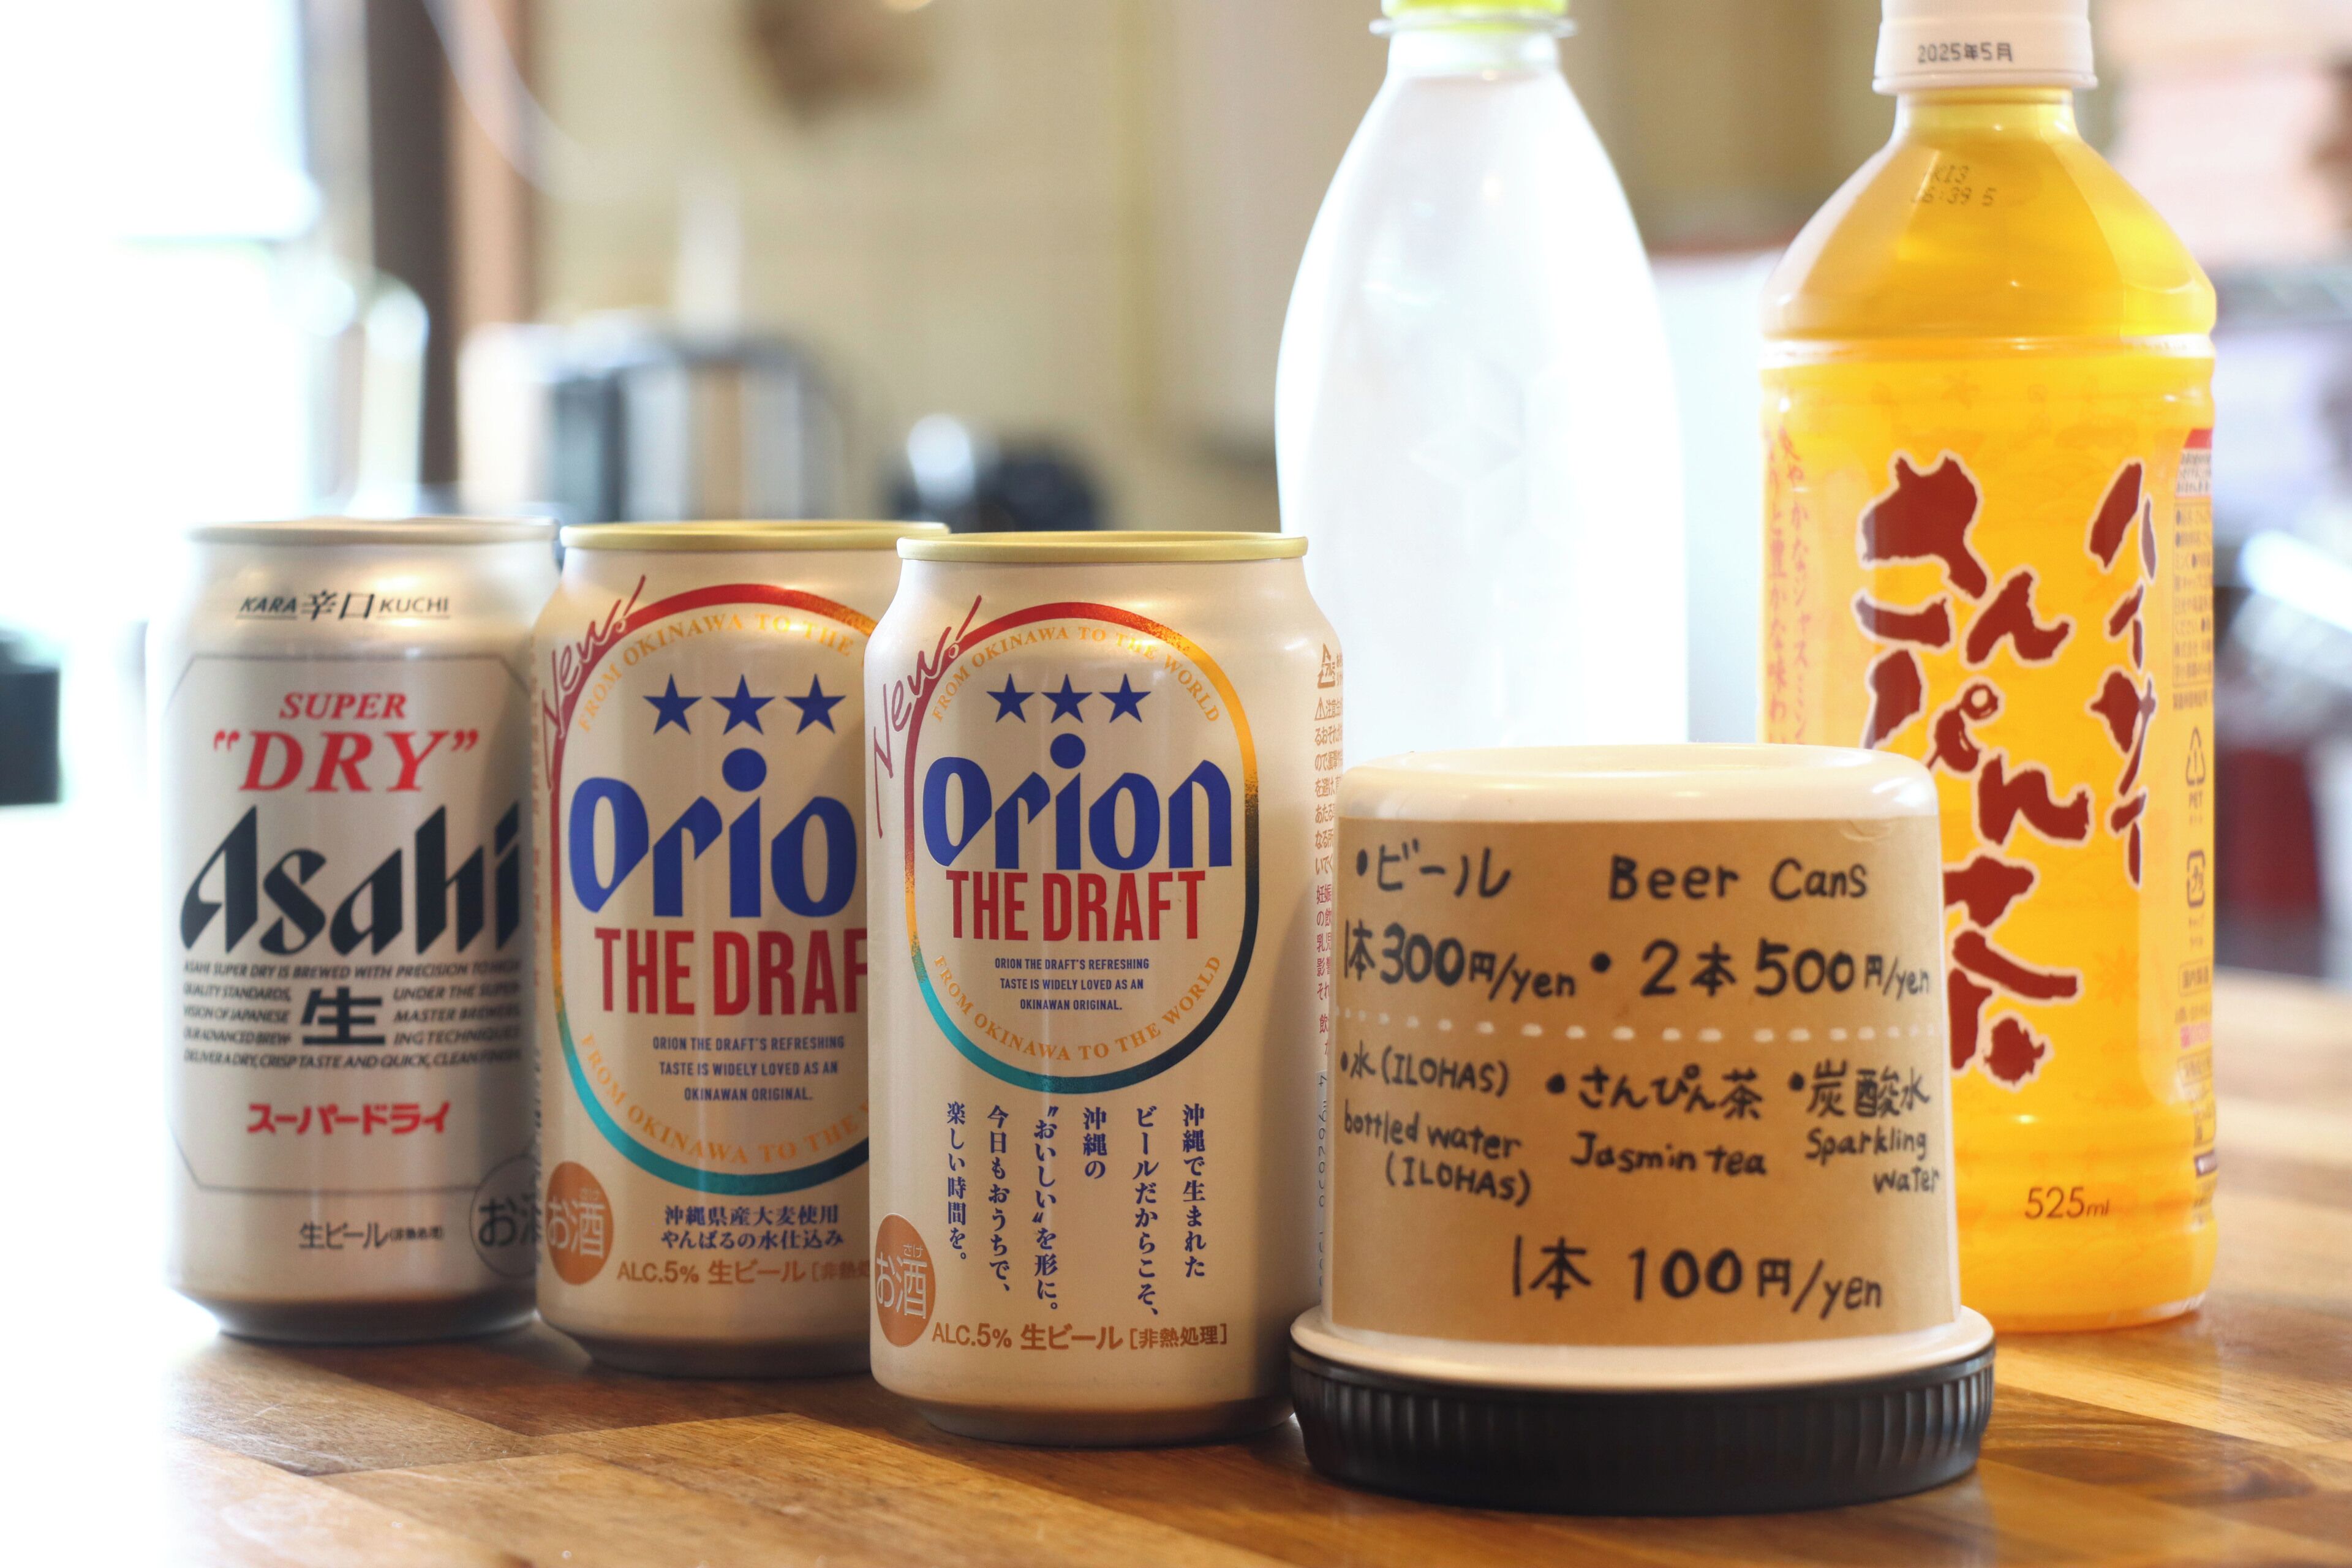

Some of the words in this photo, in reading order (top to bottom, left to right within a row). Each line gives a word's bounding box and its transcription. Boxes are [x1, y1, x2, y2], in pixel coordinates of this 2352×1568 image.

[1917, 42, 2014, 64] 2025年5月
[239, 597, 297, 613] KARA
[300, 589, 375, 621] 辛口
[378, 597, 450, 614] KUCHI
[578, 663, 622, 733] FROM
[622, 612, 744, 666] OKINAWA
[757, 614, 792, 634] TO
[802, 619, 856, 657] THE
[931, 666, 971, 723] FROM
[971, 626, 1069, 668] OKINAWA
[1077, 626, 1108, 643] TO
[1115, 631, 1157, 660] THE
[1164, 653, 1221, 724] WORLD
[279, 692, 407, 720] SUPER
[872, 595, 982, 839] New!
[922, 733, 1232, 870] Orion
[568, 747, 858, 918] Orio
[180, 801, 521, 957] Asahi
[1377, 839, 1512, 899] ビール
[1608, 854, 1740, 901] Beer
[1770, 857, 1869, 902] Cans
[946, 870, 1028, 941] THE
[1042, 870, 1205, 941] DRAFT
[213, 962, 247, 978] SUPER
[249, 964, 275, 979] DRY
[277, 965, 290, 979] IS
[292, 965, 351, 979] BREWED
[354, 966, 393, 979] WITH
[396, 963, 468, 978] PRECISION
[594, 927, 696, 1016] THE
[712, 927, 868, 1016] DRAF
[995, 957, 1022, 969] ORION
[1025, 957, 1042, 969] THE
[1044, 958, 1086, 970] DRAFT'S
[1088, 957, 1150, 970] REFRESHING
[1000, 978, 1028, 990] TASTE
[1030, 979, 1040, 990] IS
[1042, 979, 1078, 990] WIDELY
[1080, 979, 1113, 990] LOVED
[1115, 979, 1129, 990] AS
[1131, 978, 1144, 990] AN
[300, 986, 385, 1046] 生
[393, 987, 445, 1000] UNDER
[450, 986, 475, 998] THE
[394, 1008, 456, 1022] MASTER
[933, 955, 974, 1016] FROM
[974, 1012, 1071, 1061] OKINAWA
[1078, 1042, 1109, 1061] TO
[1115, 1023, 1161, 1053] THE
[1161, 956, 1221, 1026] WORLD
[1020, 998, 1070, 1010] OKINAWAN
[1073, 999, 1123, 1011] ORIGINAL.
[260, 1054, 297, 1068] CRISP
[299, 1055, 343, 1069] TASTE
[344, 1055, 378, 1068] AND
[393, 1031, 423, 1045] ING
[653, 1036, 687, 1051] ORION
[690, 1036, 712, 1051] THE
[715, 1036, 767, 1052] DRAFT'S
[771, 1035, 845, 1050] REFRESHING
[659, 1061, 695, 1076] TASTE
[697, 1062, 709, 1076] IS
[712, 1062, 758, 1076] WIDELY
[761, 1061, 801, 1076] LOVED
[803, 1061, 820, 1075] AS
[822, 1061, 839, 1074] AN
[1578, 1063, 1763, 1120] さんぴん茶
[1807, 1058, 1931, 1117] 炭酸水
[247, 1101, 451, 1135] スーパードライ
[579, 1031, 627, 1106] FROM
[627, 1104, 749, 1165] OKINAWA
[758, 1140, 797, 1164] TO
[802, 1117, 859, 1153] THE
[684, 1087, 748, 1102] OKINAWAN
[751, 1087, 814, 1101] ORIGINAL.
[1082, 1106, 1108, 1180] 沖縄の
[1343, 1099, 1420, 1145] bottled
[1427, 1126, 1523, 1160] water
[1804, 1126, 1928, 1166] Sparkling
[1570, 1131, 1698, 1174] Jasmin
[1705, 1145, 1768, 1178] tea
[947, 1101, 967, 1261] 楽しい時間を。
[987, 1104, 1011, 1292] 今日もおうちで、
[1182, 1103, 1207, 1279] 沖縄で生まれた
[1873, 1167, 1940, 1194] water
[547, 1195, 606, 1259] お酒
[665, 1204, 840, 1226] 沖縄県産大麦使用
[1133, 1106, 1159, 1316] ビールだからこそ、
[660, 1229, 844, 1251] やんばるの水仕込み
[617, 1259, 700, 1284] ALC.5%
[707, 1259, 807, 1285] 生ビール
[875, 1250, 929, 1320] お酒
[931, 1321, 1012, 1349] ALC.5%
